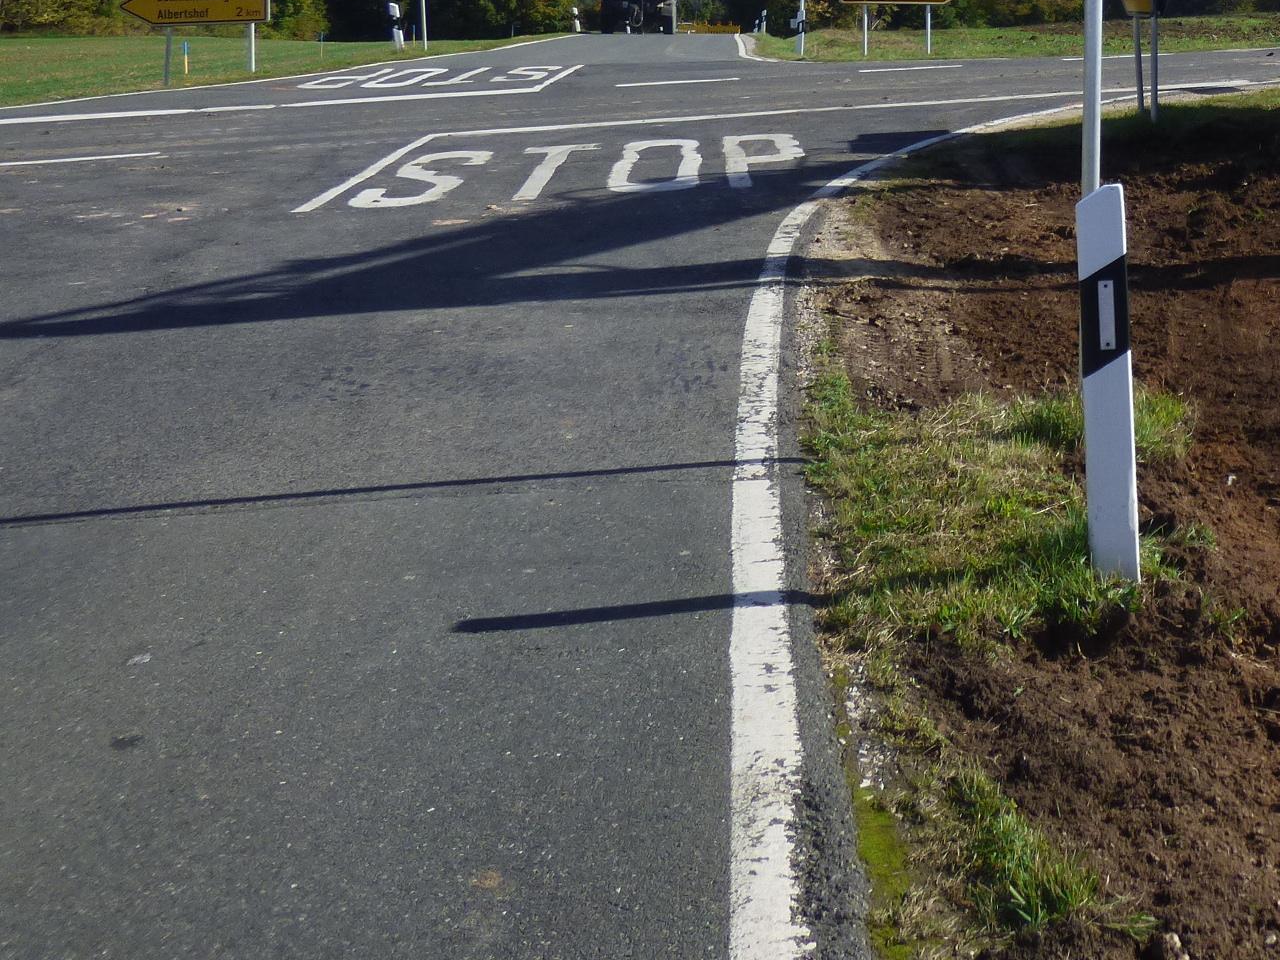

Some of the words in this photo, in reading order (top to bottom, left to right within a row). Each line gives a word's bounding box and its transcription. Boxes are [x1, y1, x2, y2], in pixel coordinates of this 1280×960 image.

[157, 8, 209, 19] Albertshof
[235, 6, 242, 17] 2
[244, 8, 262, 17] km
[347, 133, 806, 208] STOP
